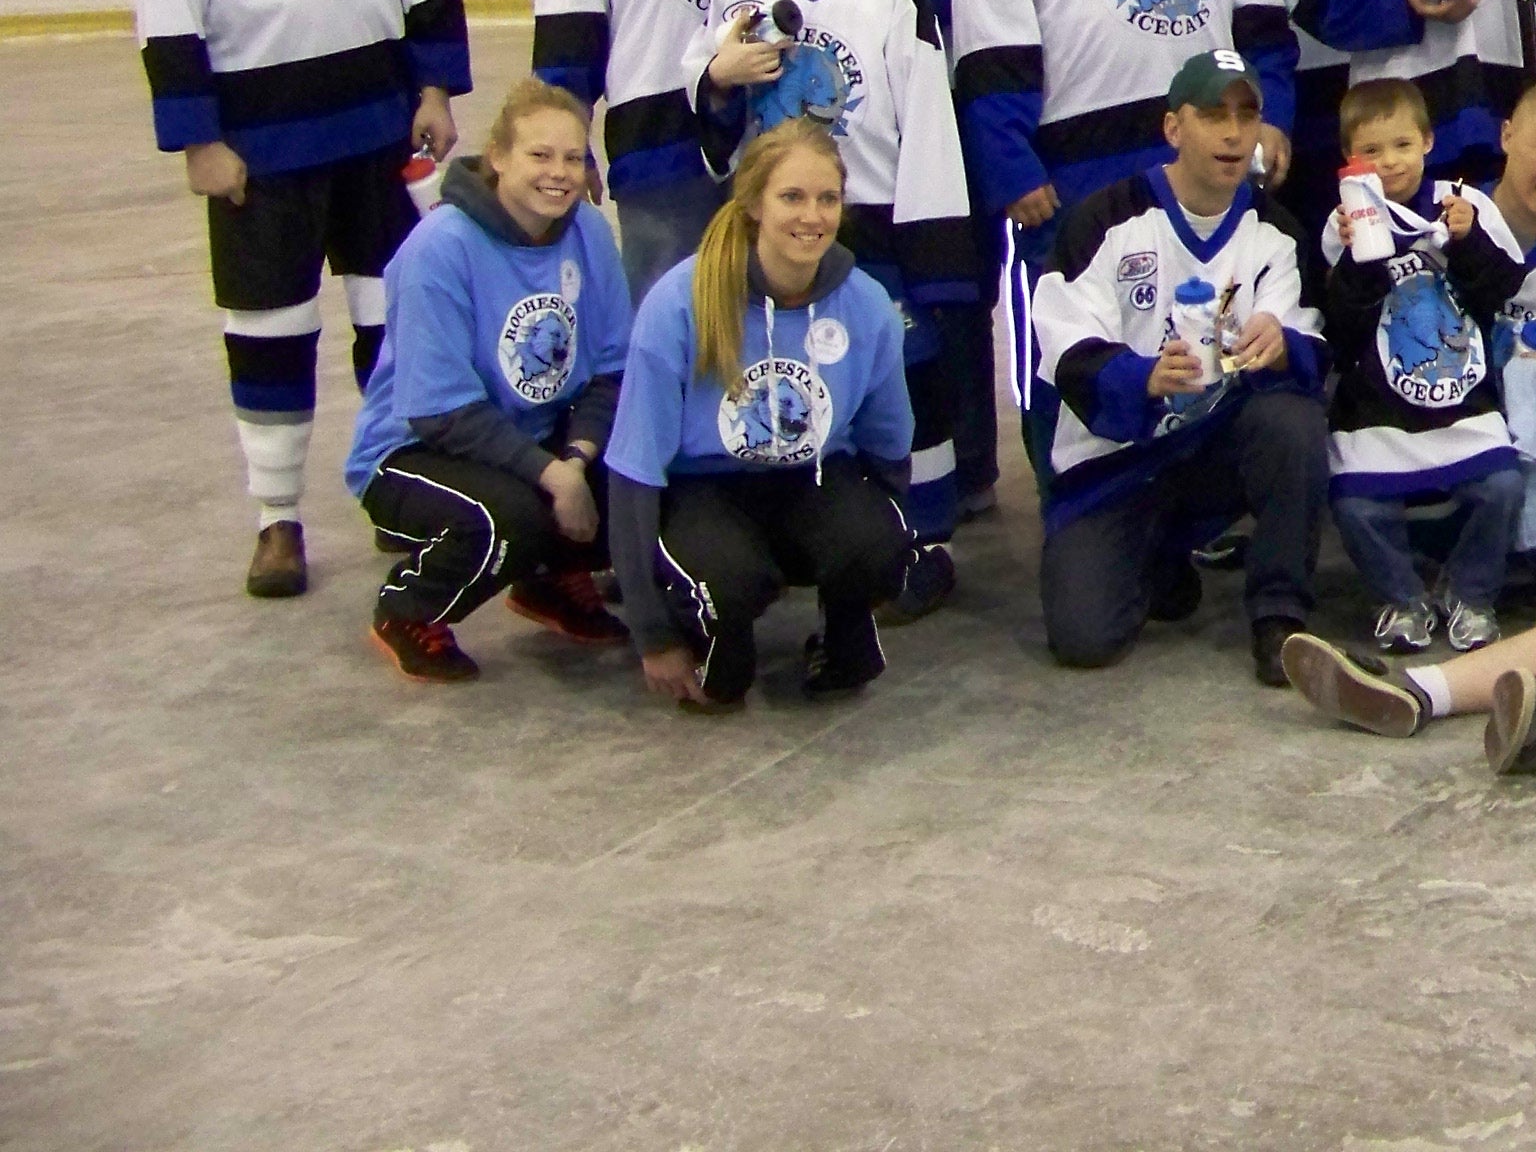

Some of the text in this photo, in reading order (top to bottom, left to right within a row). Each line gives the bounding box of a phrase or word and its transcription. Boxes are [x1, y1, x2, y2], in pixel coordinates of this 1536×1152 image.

[1127, 7, 1211, 37] ICECATS
[1213, 49, 1246, 73] S
[1393, 367, 1477, 402] ICECATS
